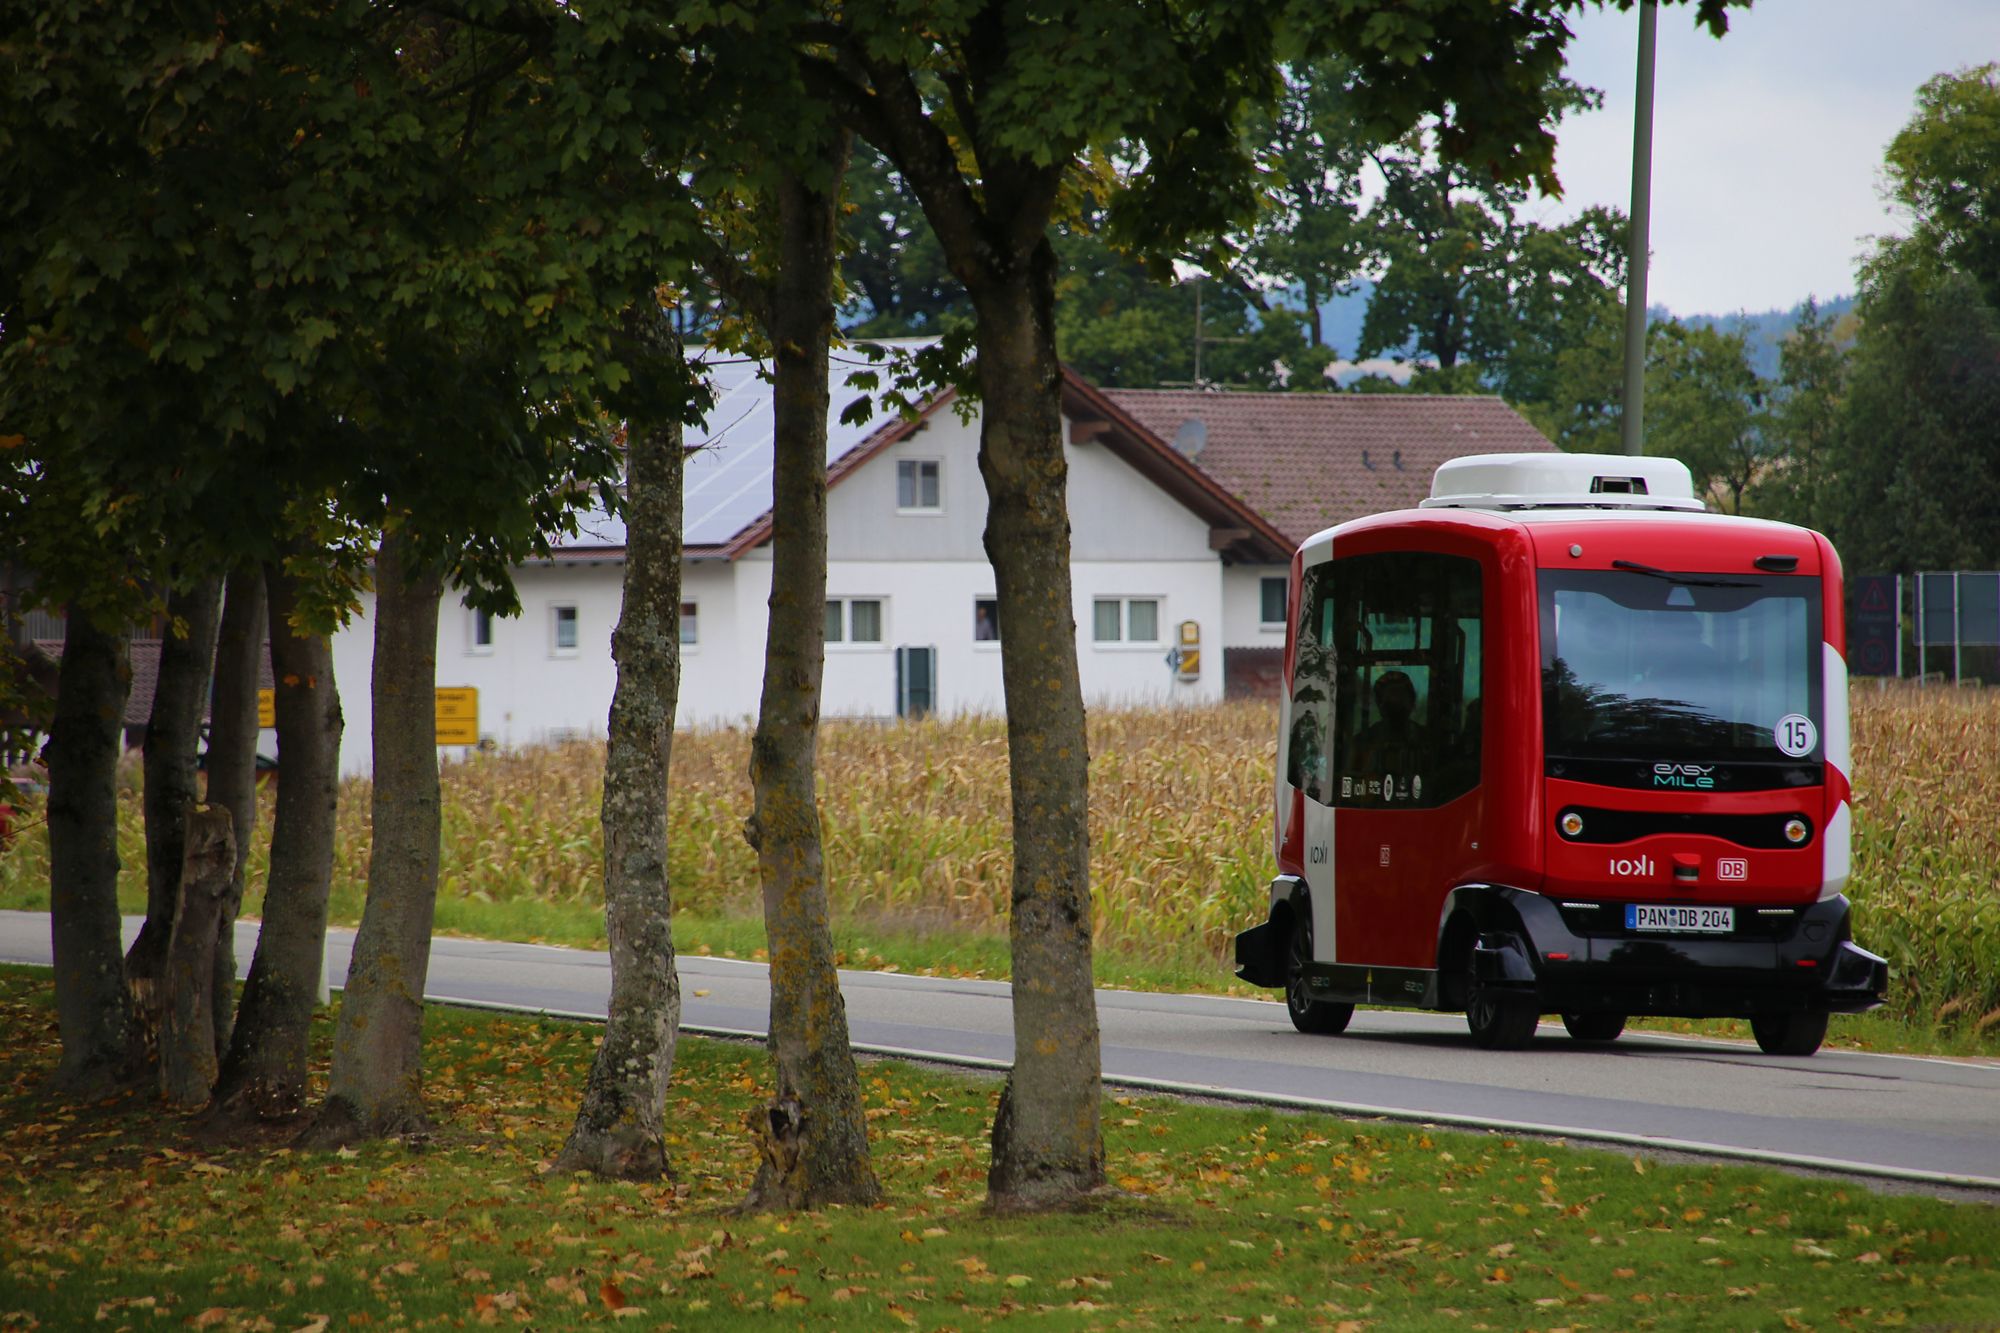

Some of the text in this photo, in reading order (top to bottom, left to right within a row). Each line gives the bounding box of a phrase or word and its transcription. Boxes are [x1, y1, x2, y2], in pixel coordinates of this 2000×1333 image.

[1784, 721, 1806, 749] 15
[1721, 861, 1744, 877] DB
[1638, 908, 1730, 928] PAN DB 204
